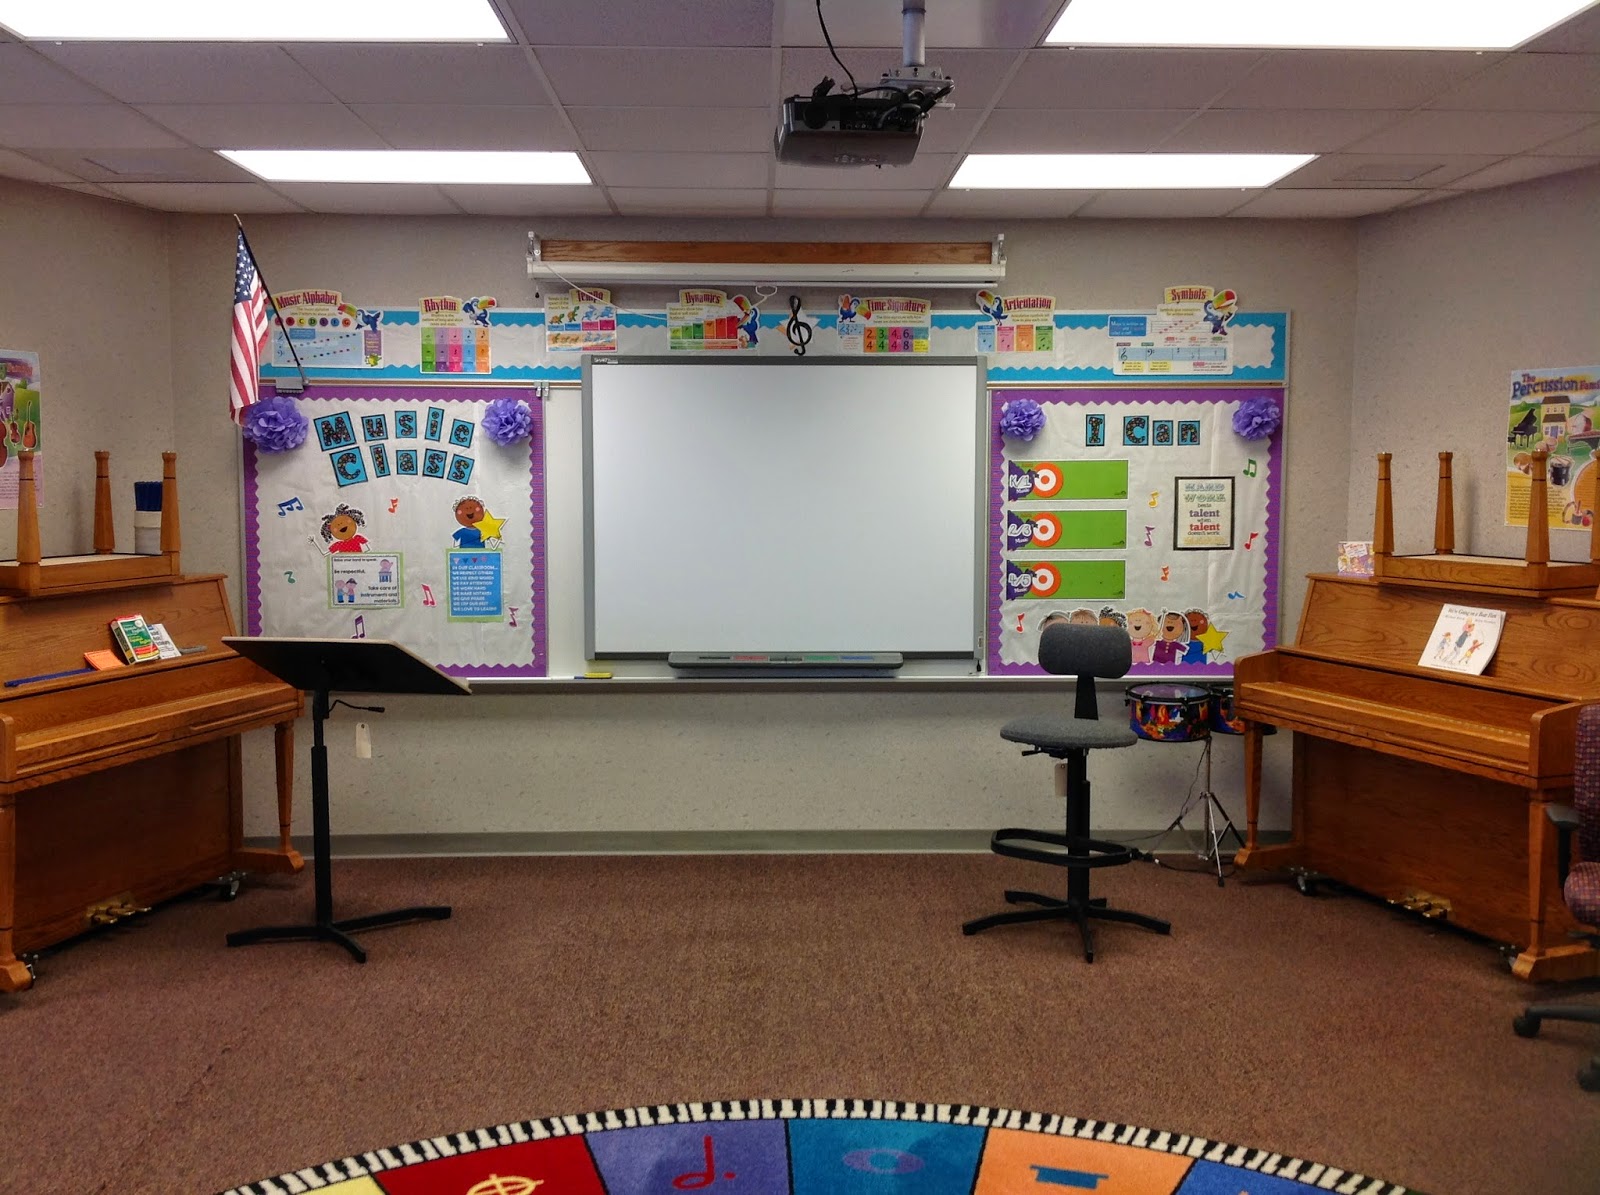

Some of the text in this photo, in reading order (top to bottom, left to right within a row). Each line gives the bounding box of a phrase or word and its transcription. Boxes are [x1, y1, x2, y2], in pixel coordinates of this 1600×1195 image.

[276, 291, 338, 309] Music Alphabet
[576, 290, 604, 304] Tempo
[685, 292, 720, 306] Dynamics
[1171, 288, 1206, 304] Symbols
[424, 298, 457, 314] Rhythm
[868, 299, 926, 312] Time Signature
[1004, 297, 1052, 310] Articulation
[867, 330, 909, 338] 2 3 4 6
[866, 341, 872, 350] 4
[879, 341, 884, 350] 4
[891, 341, 897, 350] 4
[903, 341, 909, 350] 8
[1522, 372, 1536, 382] The
[1512, 376, 1578, 399] Percussion
[320, 410, 470, 447] Music
[1088, 416, 1198, 444] I Can
[337, 448, 470, 480] Class
[1189, 509, 1220, 517] talent
[1190, 522, 1221, 531] talent
